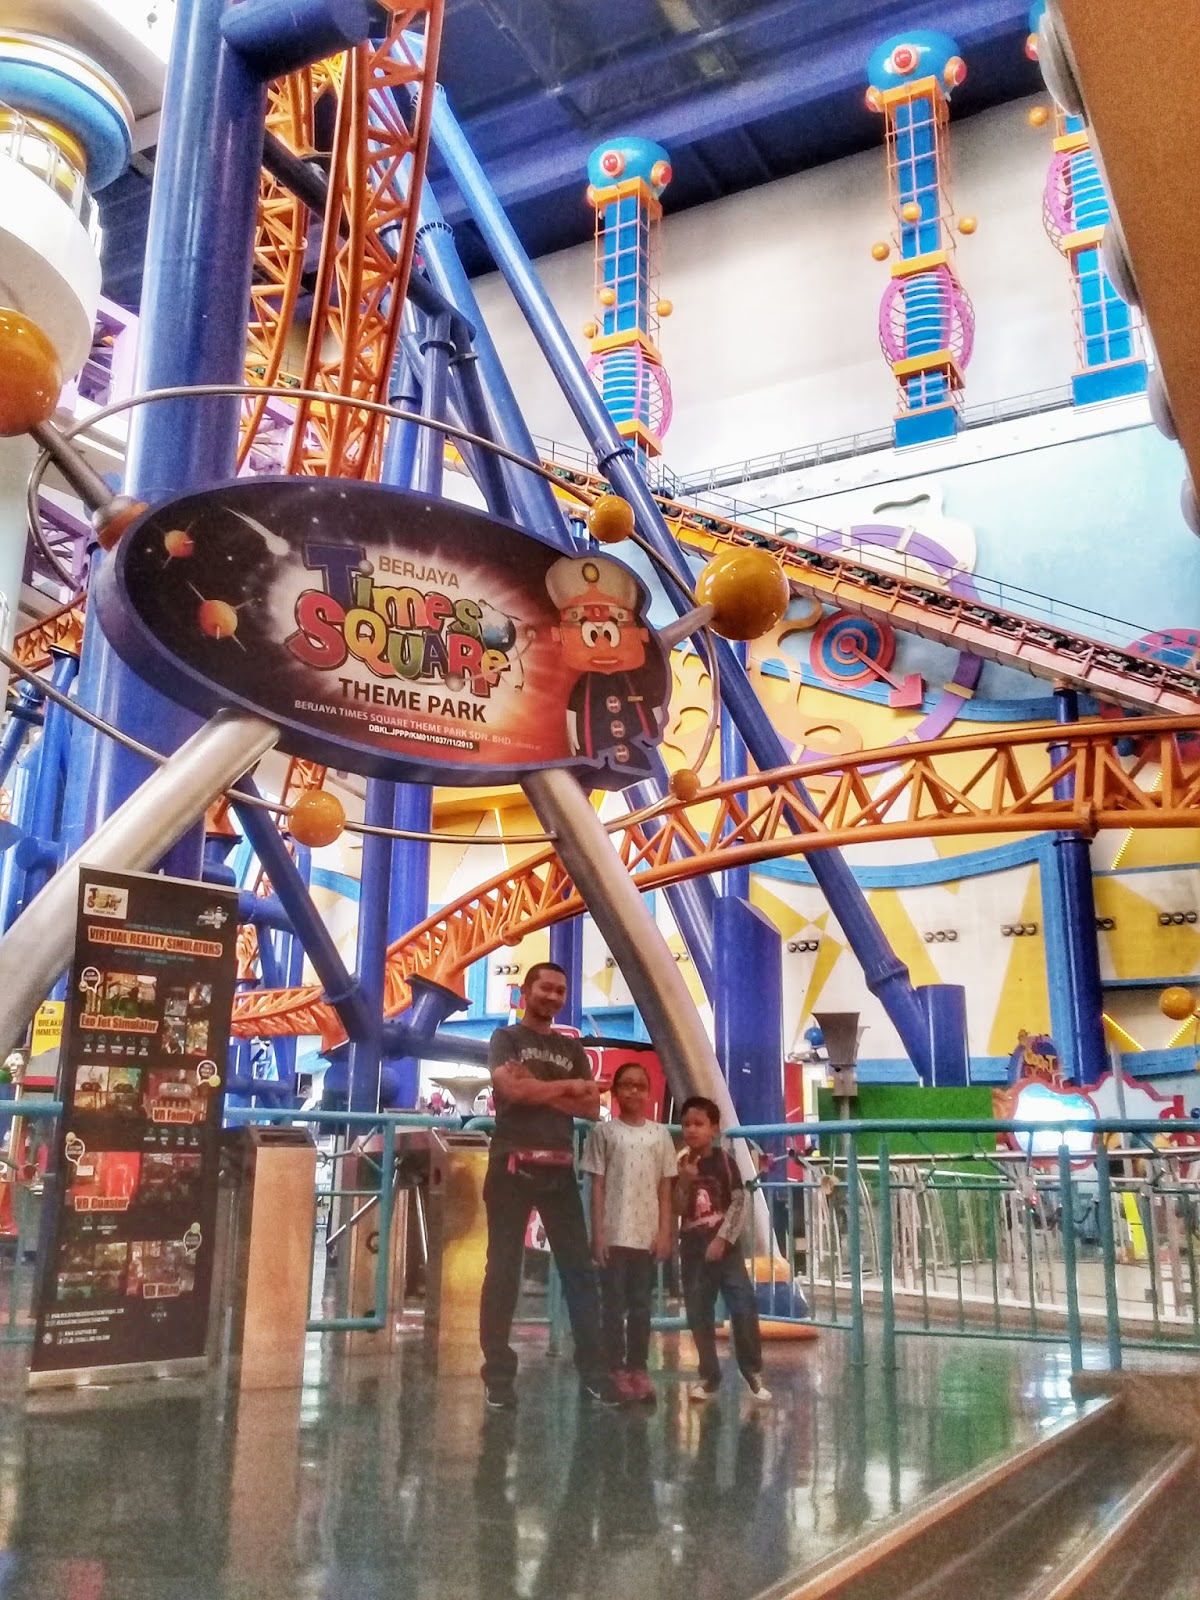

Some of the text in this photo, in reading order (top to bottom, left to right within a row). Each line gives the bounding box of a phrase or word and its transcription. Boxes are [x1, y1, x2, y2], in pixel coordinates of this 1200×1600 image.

[379, 555, 460, 589] BERJAYA
[294, 700, 337, 715] BERJAYA
[339, 707, 369, 721] TIMES
[370, 713, 409, 728] SQUARE
[410, 720, 442, 733] THEME
[443, 726, 468, 738] PARK
[338, 678, 487, 724] THEME PARK
[89, 927, 129, 943] VIRTUAL
[129, 932, 165, 949] REALITY
[166, 936, 222, 955] SIMULATORS
